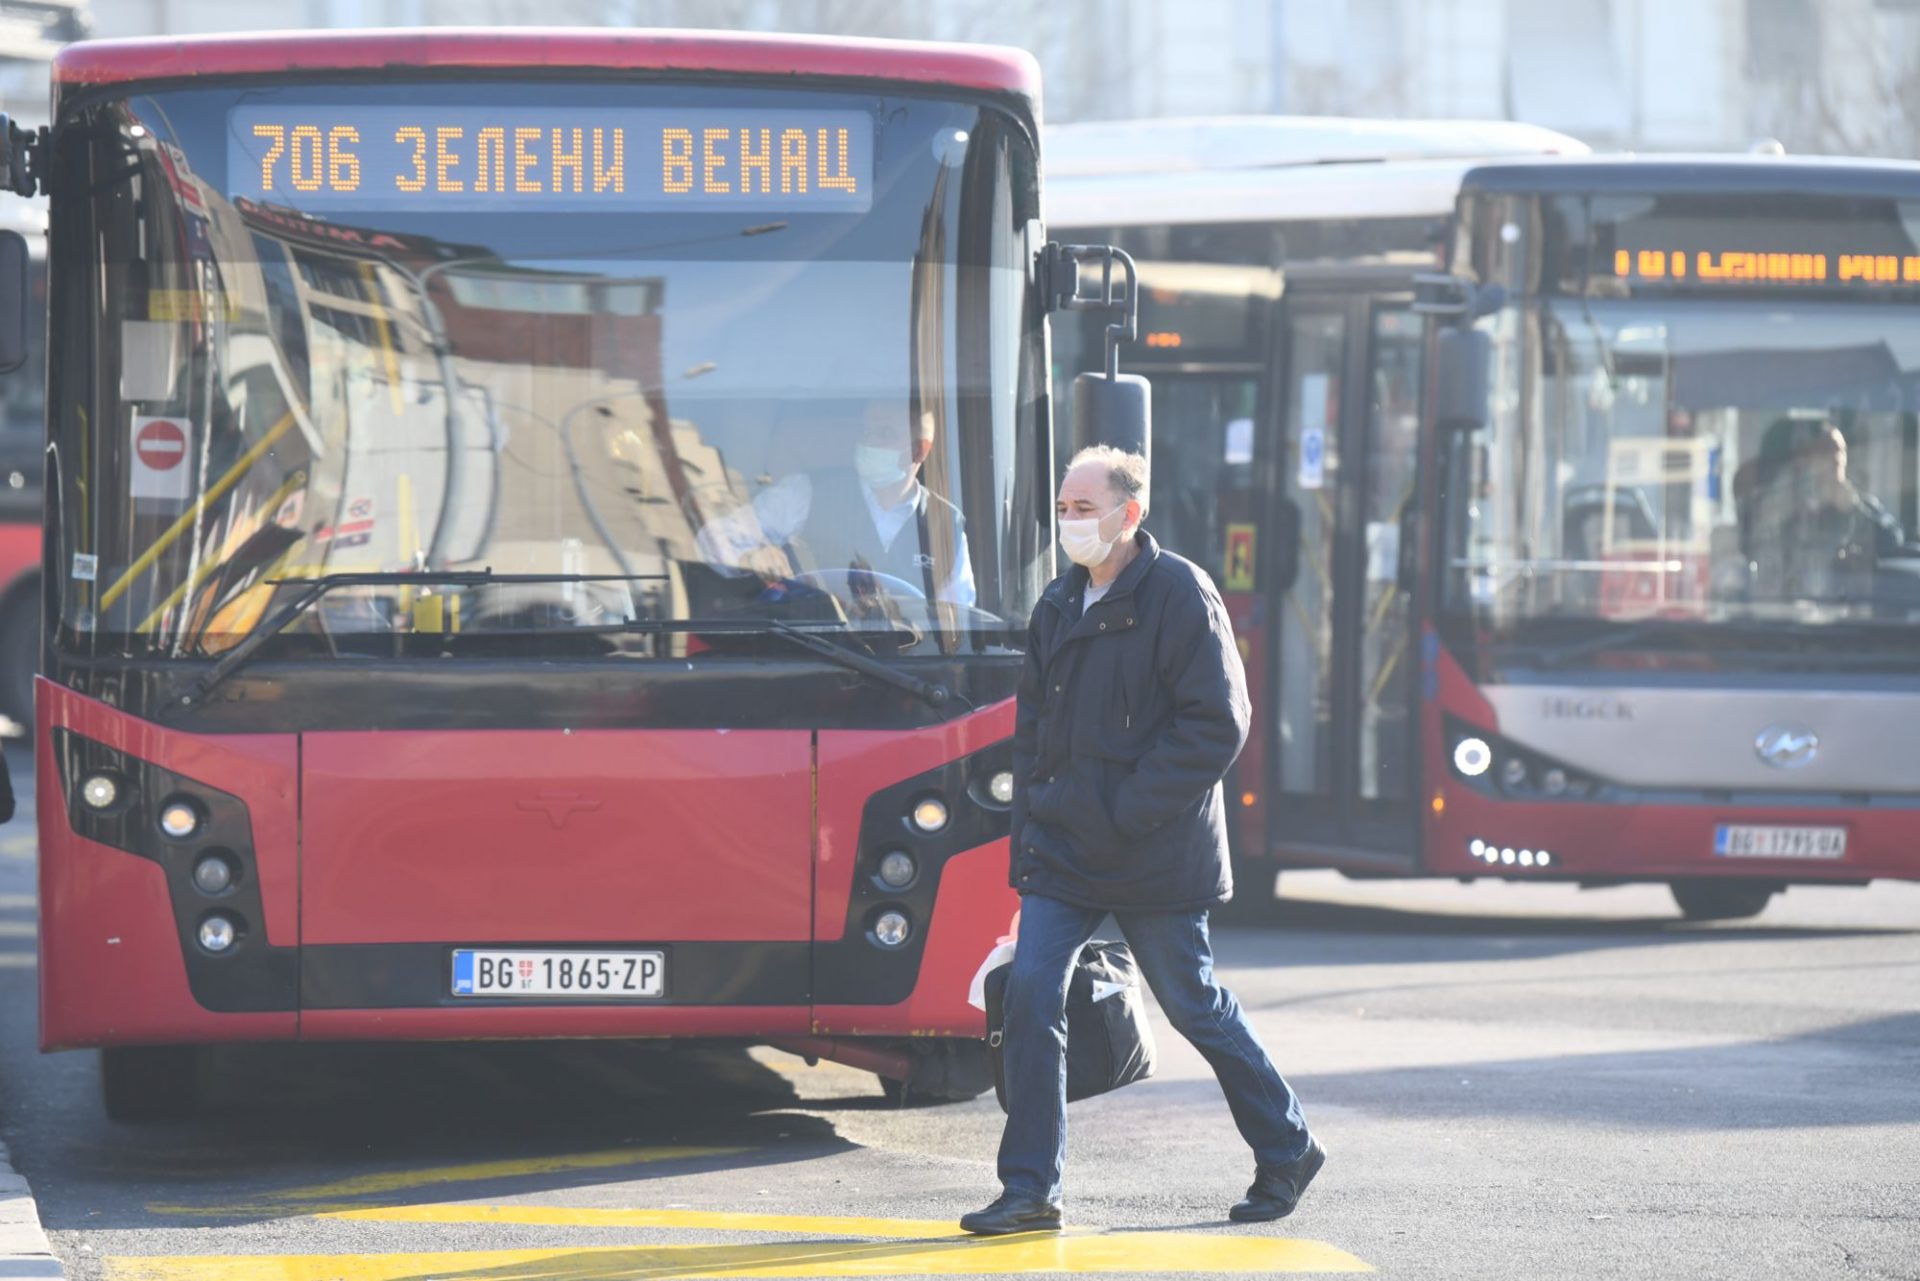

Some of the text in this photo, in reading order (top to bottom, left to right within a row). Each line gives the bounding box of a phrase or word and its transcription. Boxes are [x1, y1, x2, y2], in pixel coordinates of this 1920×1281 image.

[253, 125, 857, 194] 706 ЗЕЛЕНИ ВЕНАЦ
[479, 957, 514, 989] BG
